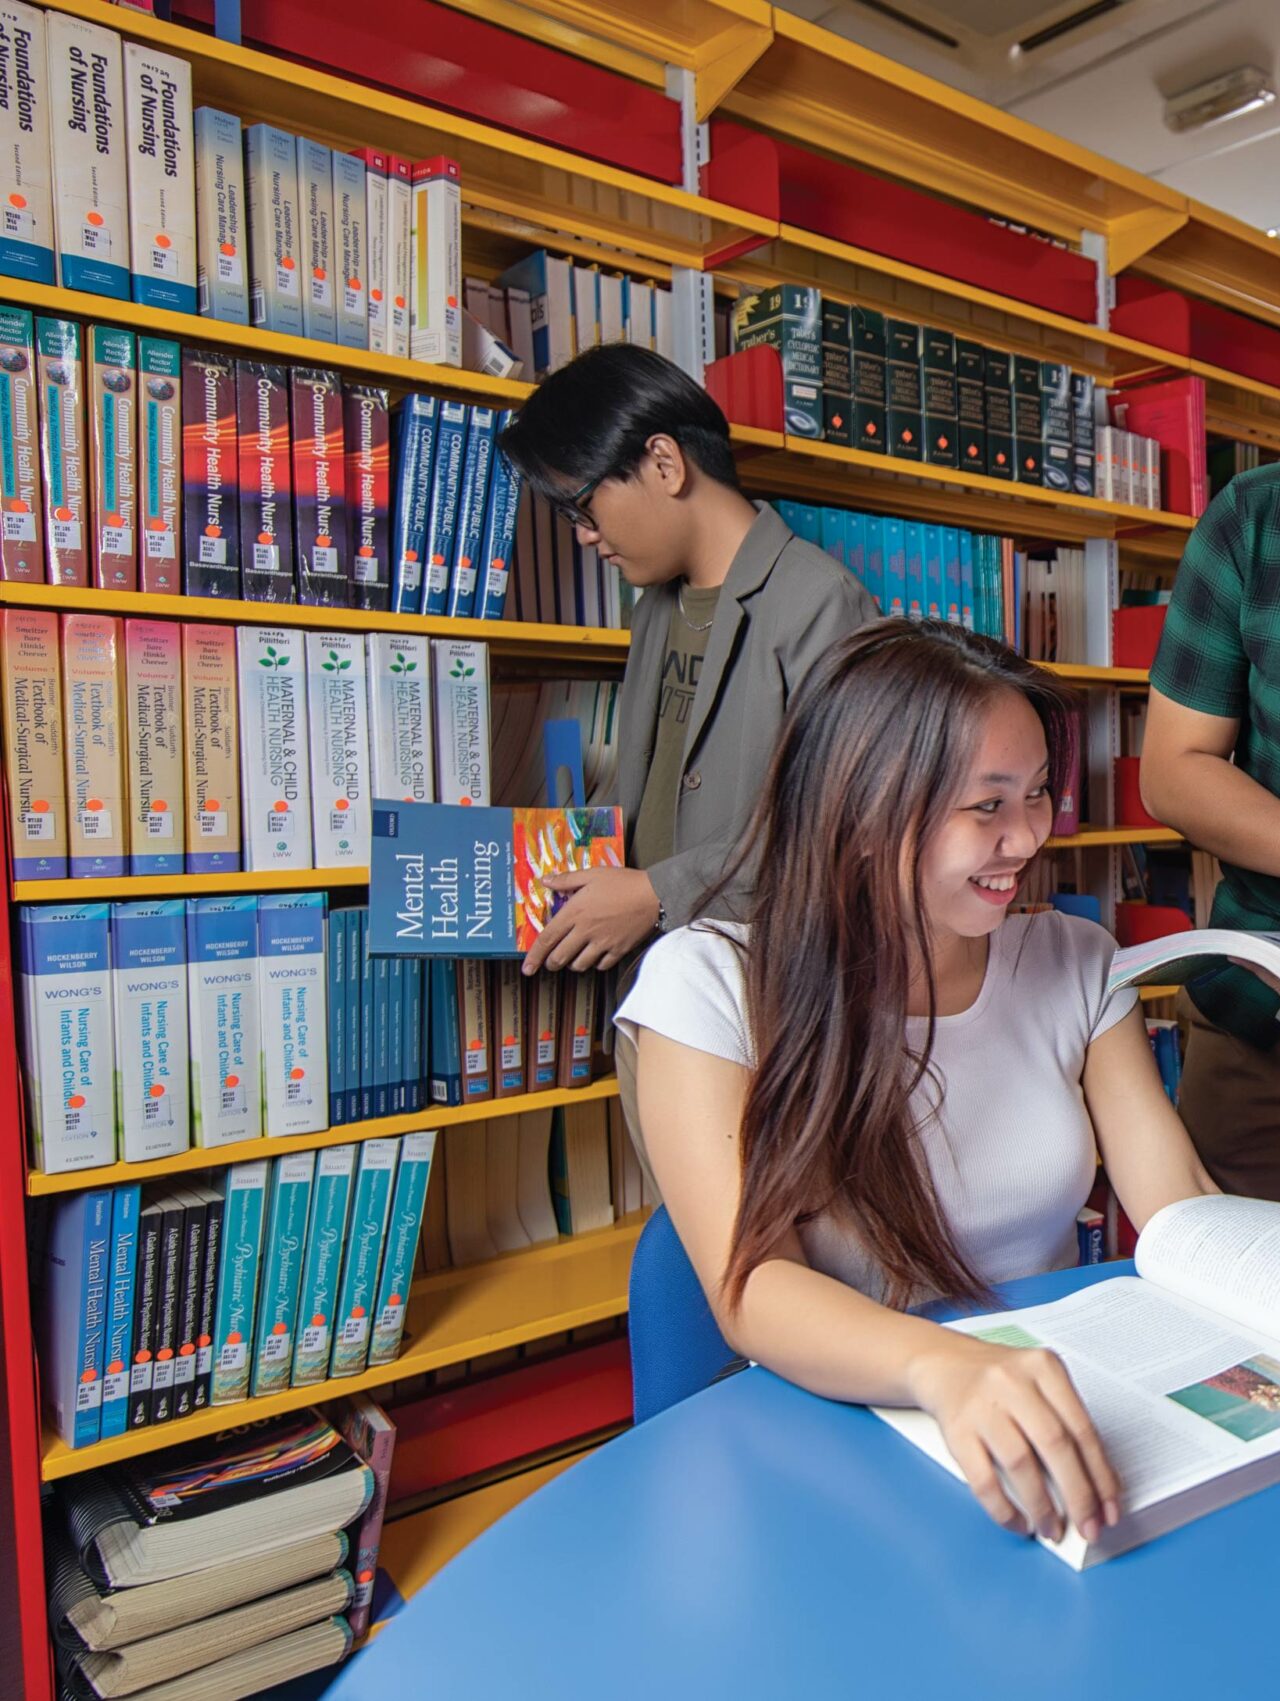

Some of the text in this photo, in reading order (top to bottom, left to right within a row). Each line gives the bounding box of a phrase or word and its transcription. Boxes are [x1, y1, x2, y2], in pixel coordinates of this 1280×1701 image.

[14, 27, 36, 132] Foundations
[68, 46, 90, 133] of Nursing
[91, 53, 112, 154] Foundations
[139, 74, 159, 157] of Nursing
[161, 80, 181, 177] Foundations
[215, 155, 226, 212] Nursing Care
[229, 184, 238, 234] Leadership
[272, 171, 280, 206] Nursing
[310, 183, 318, 217] Nursing
[342, 194, 350, 228] Nursing
[284, 200, 292, 249] Leadership
[320, 212, 328, 259] Leadership
[770, 294, 781, 310] 19
[13, 378, 35, 482] Community Health
[62, 390, 81, 491] Community Health
[116, 398, 134, 497] Community Health
[158, 406, 176, 503] Community Health
[203, 367, 222, 490] Community Health
[256, 378, 276, 498] Community Health
[312, 384, 331, 502] Community Health
[359, 400, 375, 513] Community Health
[414, 428, 432, 532] COMMUNITY/PUBLIC
[442, 434, 462, 536] COMMUNITY/PUBLIC
[470, 439, 490, 539] COMMUNITY/PUBLIC
[495, 486, 506, 536] NURSING
[20, 642, 46, 651] Hinkle
[14, 677, 32, 774] Medical-Surgical
[32, 678, 49, 746] Textbook of
[73, 681, 89, 776] Medical-Surgical
[90, 682, 106, 747] Textbook of
[137, 685, 153, 777] Medical-Surgical
[153, 685, 169, 749] Textbook of
[193, 687, 209, 777] Medical-Surgical
[208, 687, 223, 749] Textbook of
[266, 676, 284, 786] HEALTH NURSING
[280, 676, 298, 800] MATERNAL & CHILD
[329, 679, 345, 787] HEALTH NURSING
[342, 680, 359, 800] MATERNAL & CHILD
[397, 681, 412, 786] HEALTH NURSING
[408, 682, 425, 799] MATERNAL & CHILD
[455, 685, 470, 786] HEALTH NURSING
[467, 686, 482, 799] MATERNAL & CHILD
[396, 853, 424, 940] Mental
[430, 857, 459, 940] Health
[465, 840, 499, 940] Nursing
[47, 952, 98, 962] HOCKENBERRY
[60, 961, 87, 969] WILSON
[129, 947, 176, 957] HOCKENBERRY
[140, 955, 166, 963] WILSON
[205, 941, 249, 951] HOCKENBERRY
[216, 948, 239, 956] WILSON
[269, 967, 318, 979] WONG'S
[271, 936, 314, 945] HOCKENBERRY
[281, 943, 305, 951] WILSON
[45, 987, 102, 1000] WONG'S
[127, 980, 180, 993] WONG'S
[204, 973, 252, 985] WONG'S
[282, 988, 293, 1039] Infants and
[61, 1009, 74, 1067] Infants and
[77, 1008, 93, 1086] Nursing Care of
[140, 1002, 153, 1056] Infants and
[156, 1000, 170, 1076] Nursing Care of
[217, 994, 228, 1046] Infants and
[231, 992, 244, 1066] Nursing Care of
[295, 986, 309, 1058] Nursing Care of
[113, 1232, 133, 1321] Mental Health
[231, 1243, 253, 1303] Psychiatric
[277, 1236, 298, 1295] Psychiatric
[317, 1228, 338, 1286] Psychiatric
[356, 1221, 379, 1278] Psychiatric
[394, 1211, 416, 1269] Psychiatric
[86, 1239, 106, 1329] Mental Health
